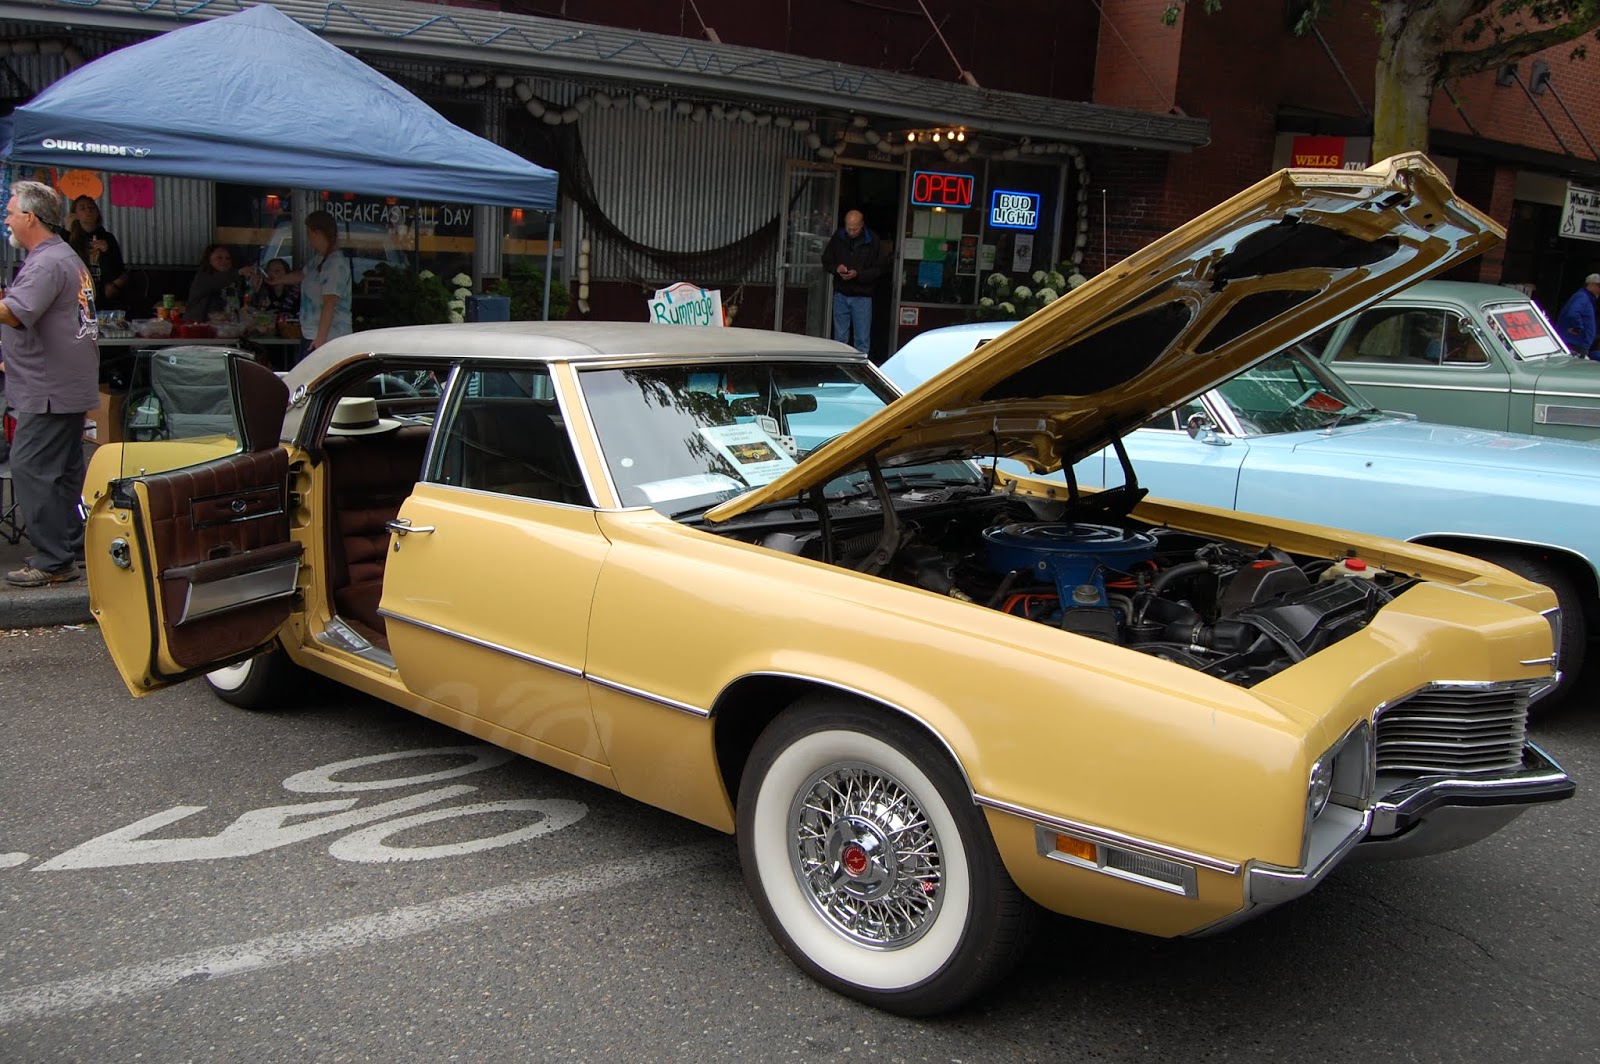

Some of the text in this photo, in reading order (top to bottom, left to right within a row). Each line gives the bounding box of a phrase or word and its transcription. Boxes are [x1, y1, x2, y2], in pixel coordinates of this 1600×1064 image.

[42, 139, 126, 156] QUIK SHADE
[1295, 154, 1339, 167] WELLS
[1343, 161, 1367, 171] ATM
[914, 174, 972, 205] OPEN
[1000, 194, 1031, 211] BUD
[440, 204, 471, 226] DAY
[992, 208, 1036, 226] LIGHT
[653, 297, 714, 326] Rummage
[1503, 311, 1532, 327] FOR
[1507, 324, 1547, 340] SALE
